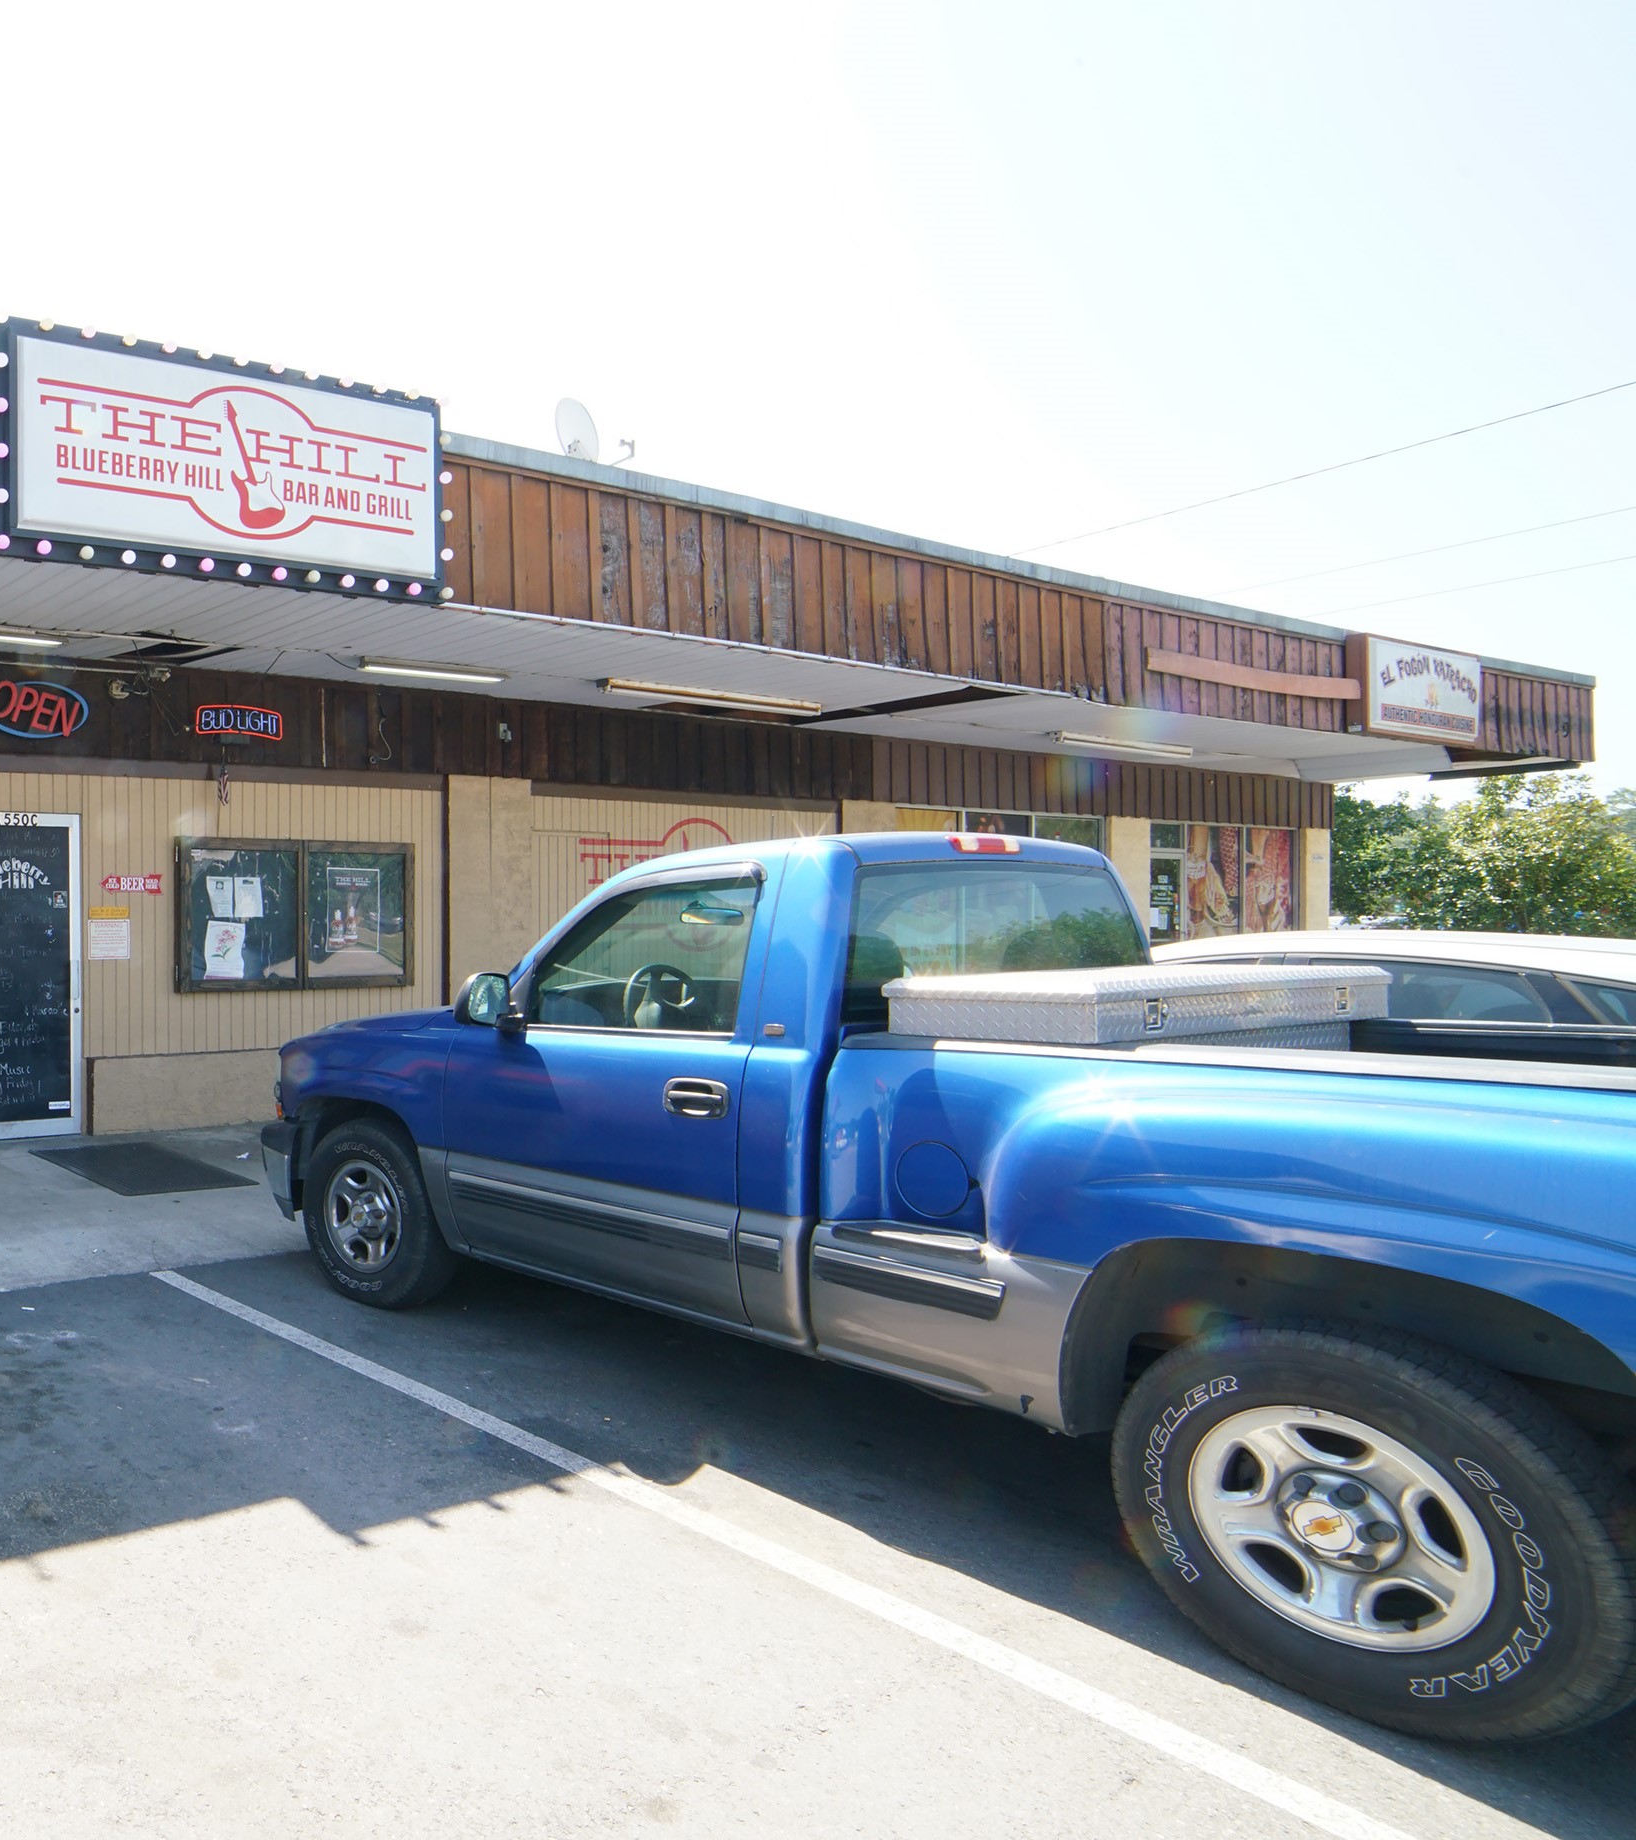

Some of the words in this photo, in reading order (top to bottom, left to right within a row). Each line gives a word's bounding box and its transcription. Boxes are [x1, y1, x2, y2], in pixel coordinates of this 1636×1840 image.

[39, 394, 222, 456] THE
[245, 428, 427, 492] HILL
[56, 443, 179, 485] BLUEBERRY
[184, 464, 224, 492] HILL
[283, 479, 320, 507] BAR
[324, 484, 361, 513] AND
[366, 491, 413, 521] GRILL
[1380, 664, 1396, 687] EL
[201, 709, 234, 731] BUD
[237, 709, 278, 735] LIGHT
[120, 877, 145, 891] BEER
[0, 1063, 31, 1076] Music
[1142, 1375, 1239, 1583] WRANGLER
[1409, 1457, 1552, 1698] GOODYEAR
